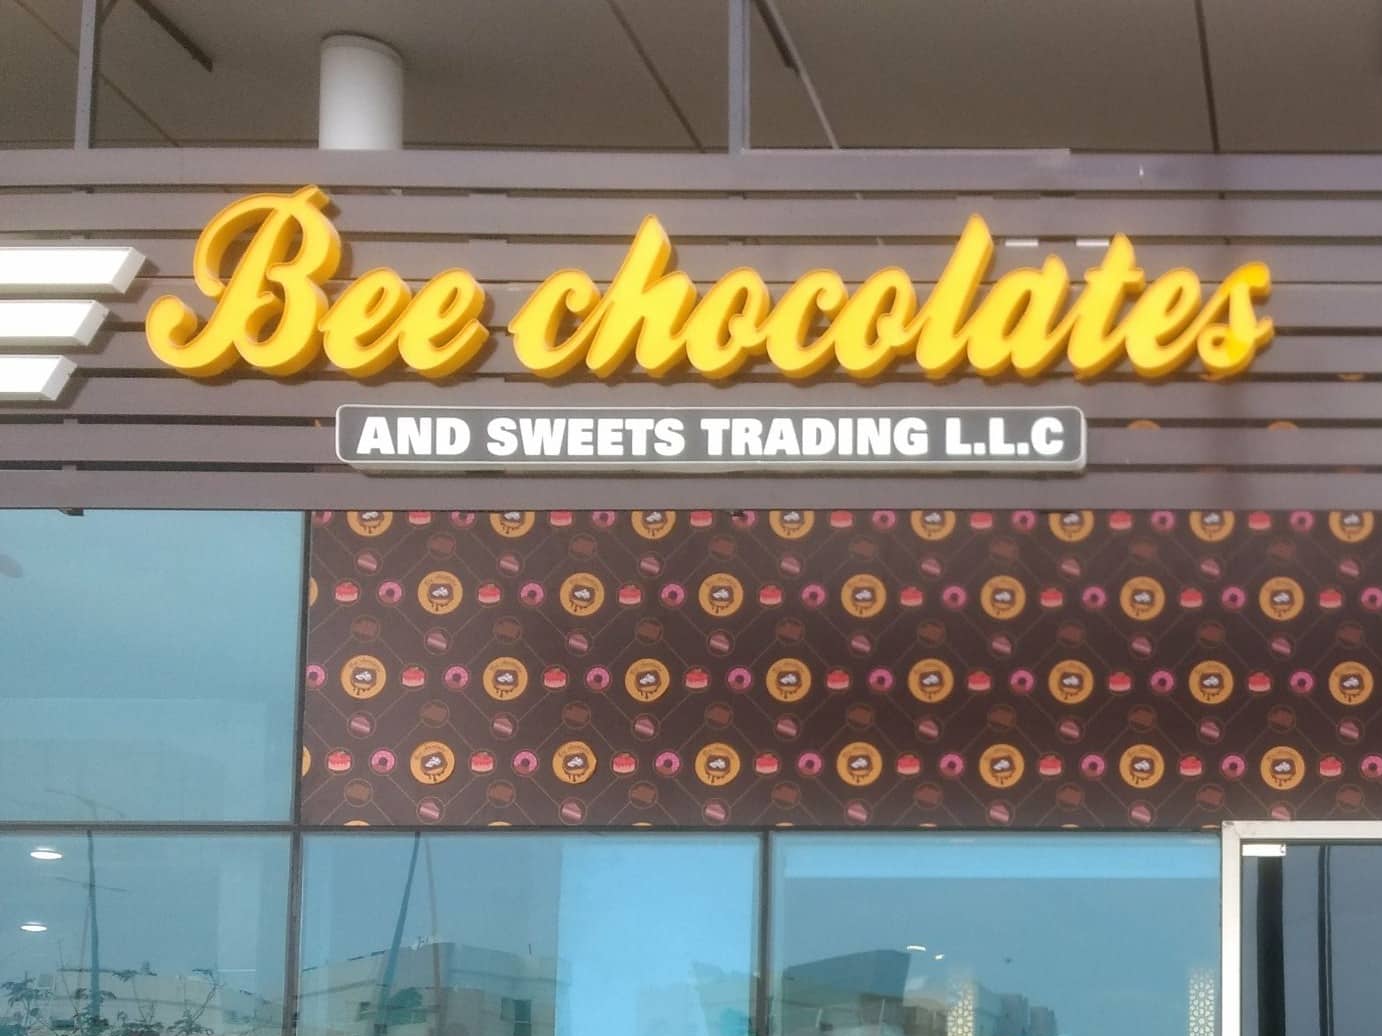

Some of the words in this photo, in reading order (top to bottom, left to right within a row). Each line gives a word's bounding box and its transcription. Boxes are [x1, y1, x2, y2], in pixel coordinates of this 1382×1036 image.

[145, 184, 490, 378] Bee
[508, 211, 1275, 380] chocolates
[356, 416, 471, 456] AND
[486, 416, 685, 457] SWEETS
[700, 416, 929, 456] TRADING
[945, 416, 1064, 456] L.L.C
